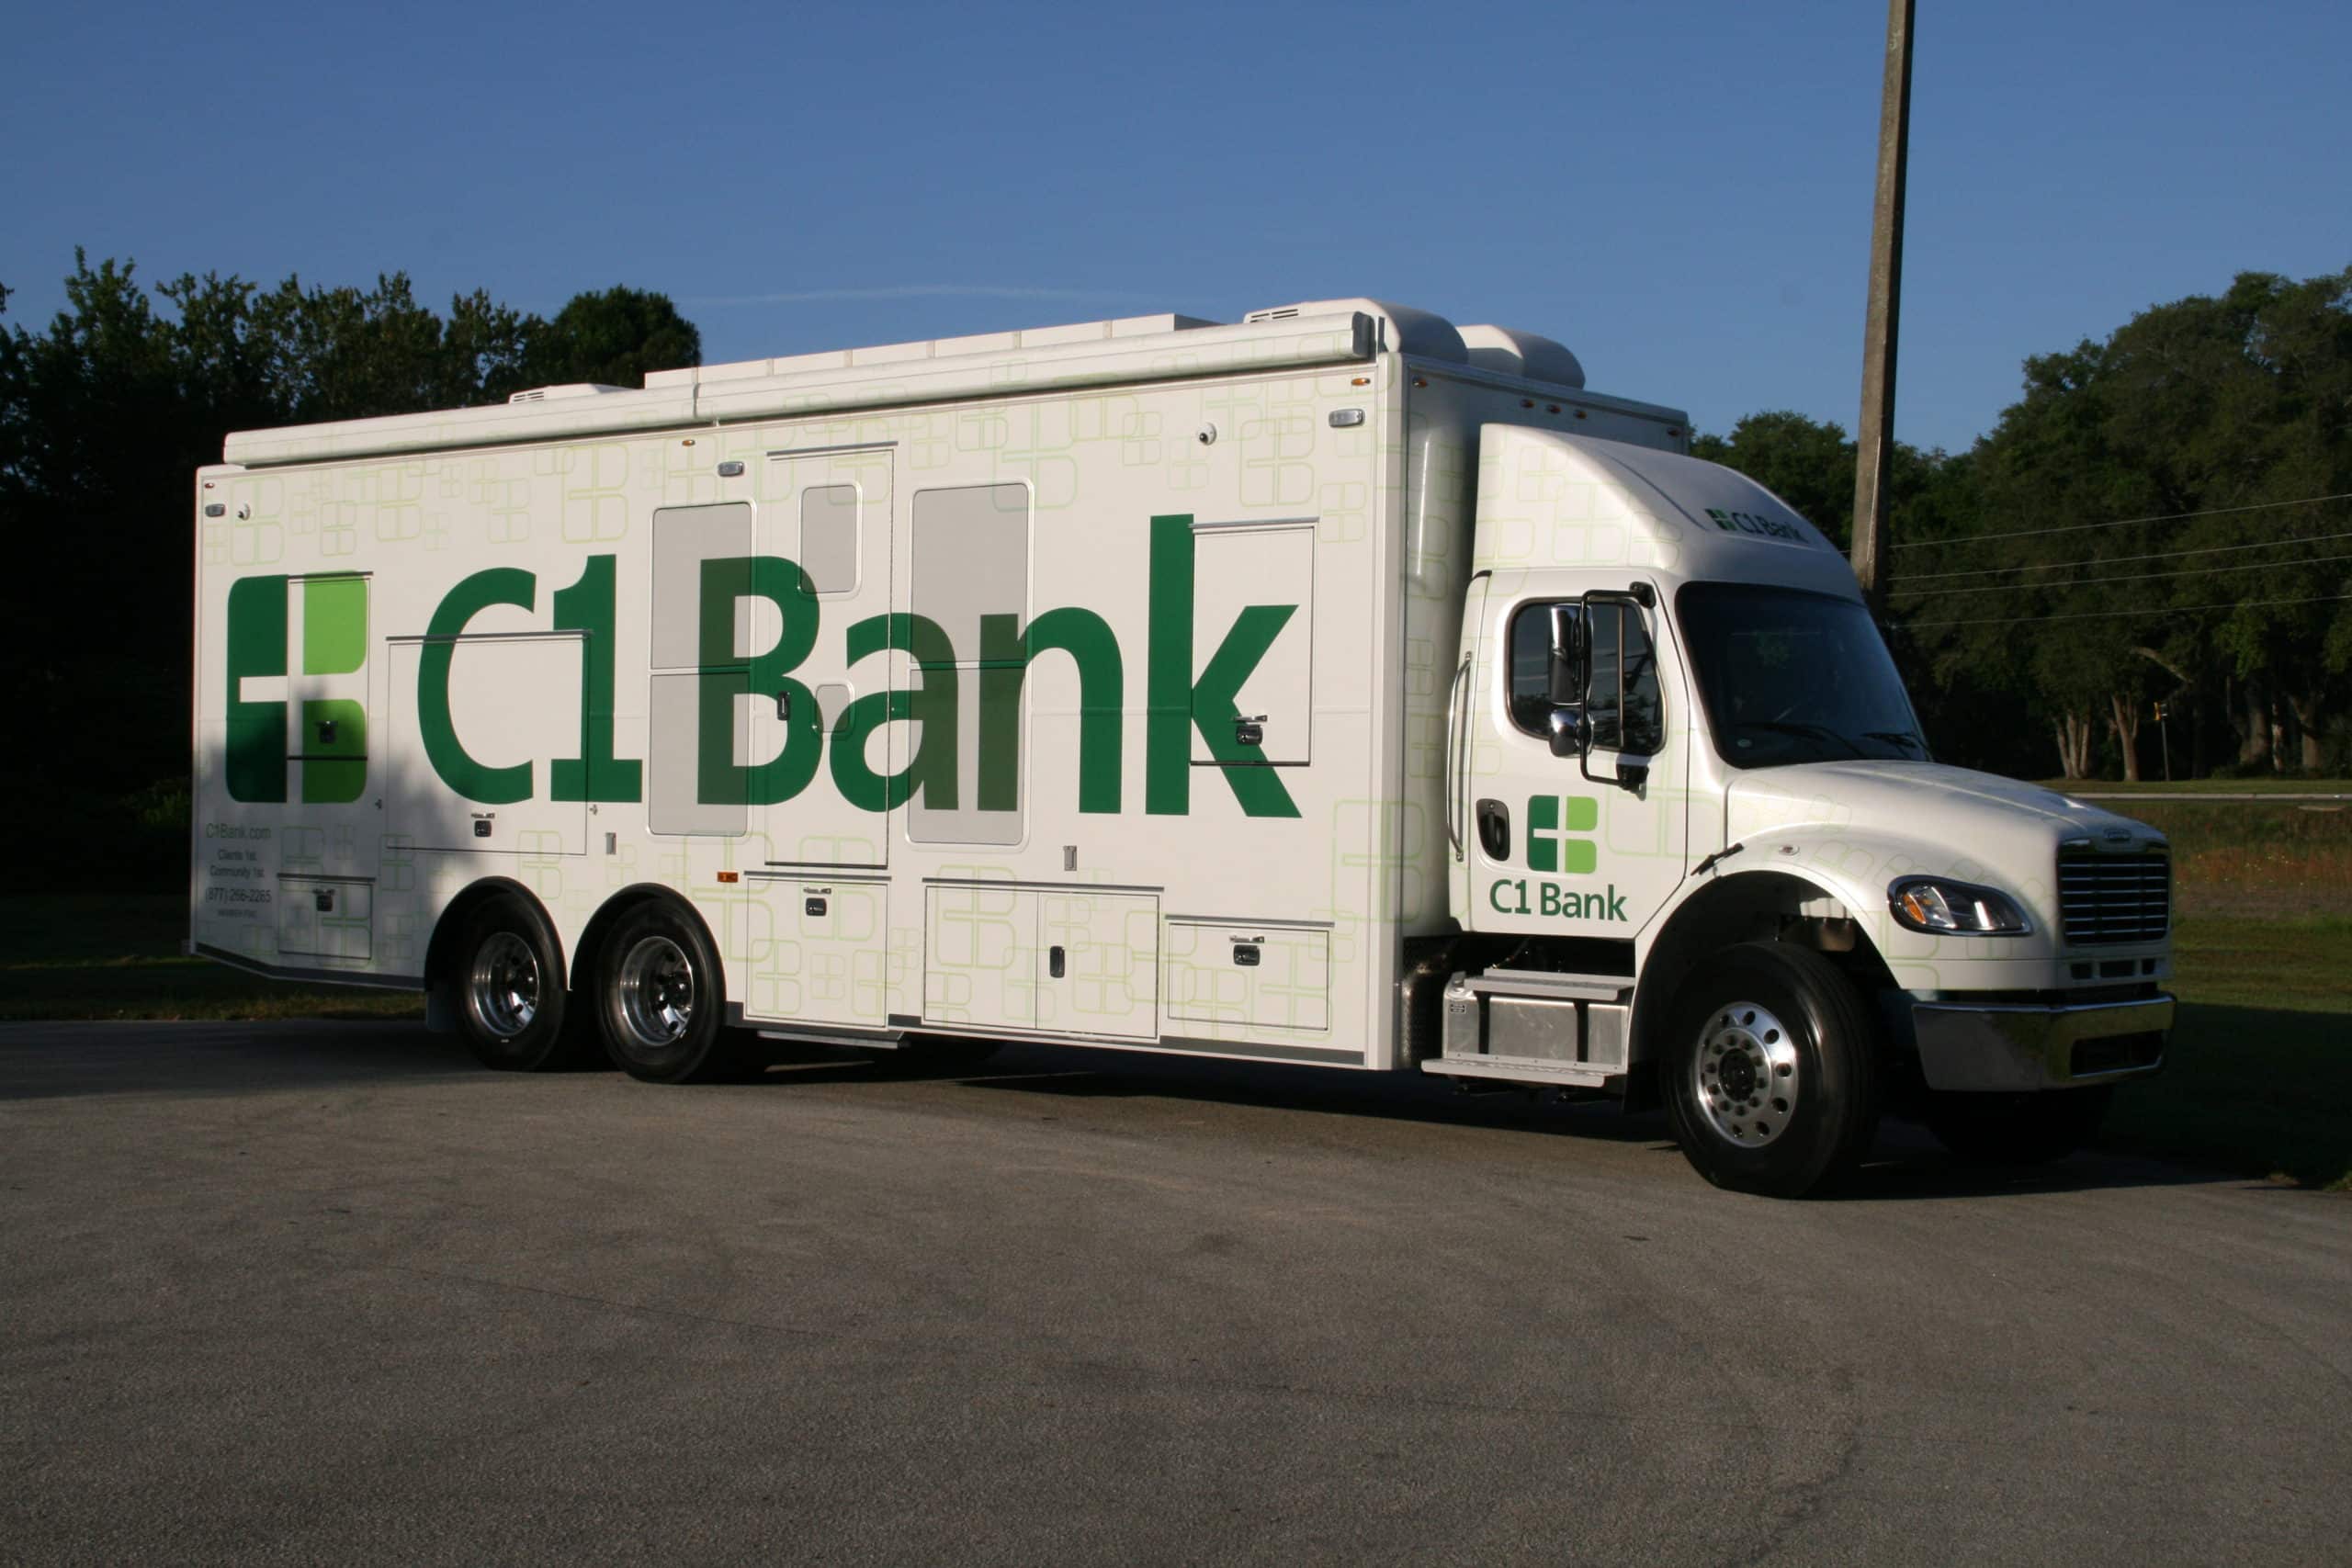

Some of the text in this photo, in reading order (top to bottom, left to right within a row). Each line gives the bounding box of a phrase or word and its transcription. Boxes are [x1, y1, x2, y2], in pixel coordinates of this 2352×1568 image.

[1755, 514, 1810, 544] Bank
[418, 513, 1302, 818] C1 Bank
[206, 823, 272, 839] C1Bank.com
[209, 865, 250, 880] Community
[206, 887, 228, 905] (877)
[1489, 879, 1628, 921] C1 Bank
